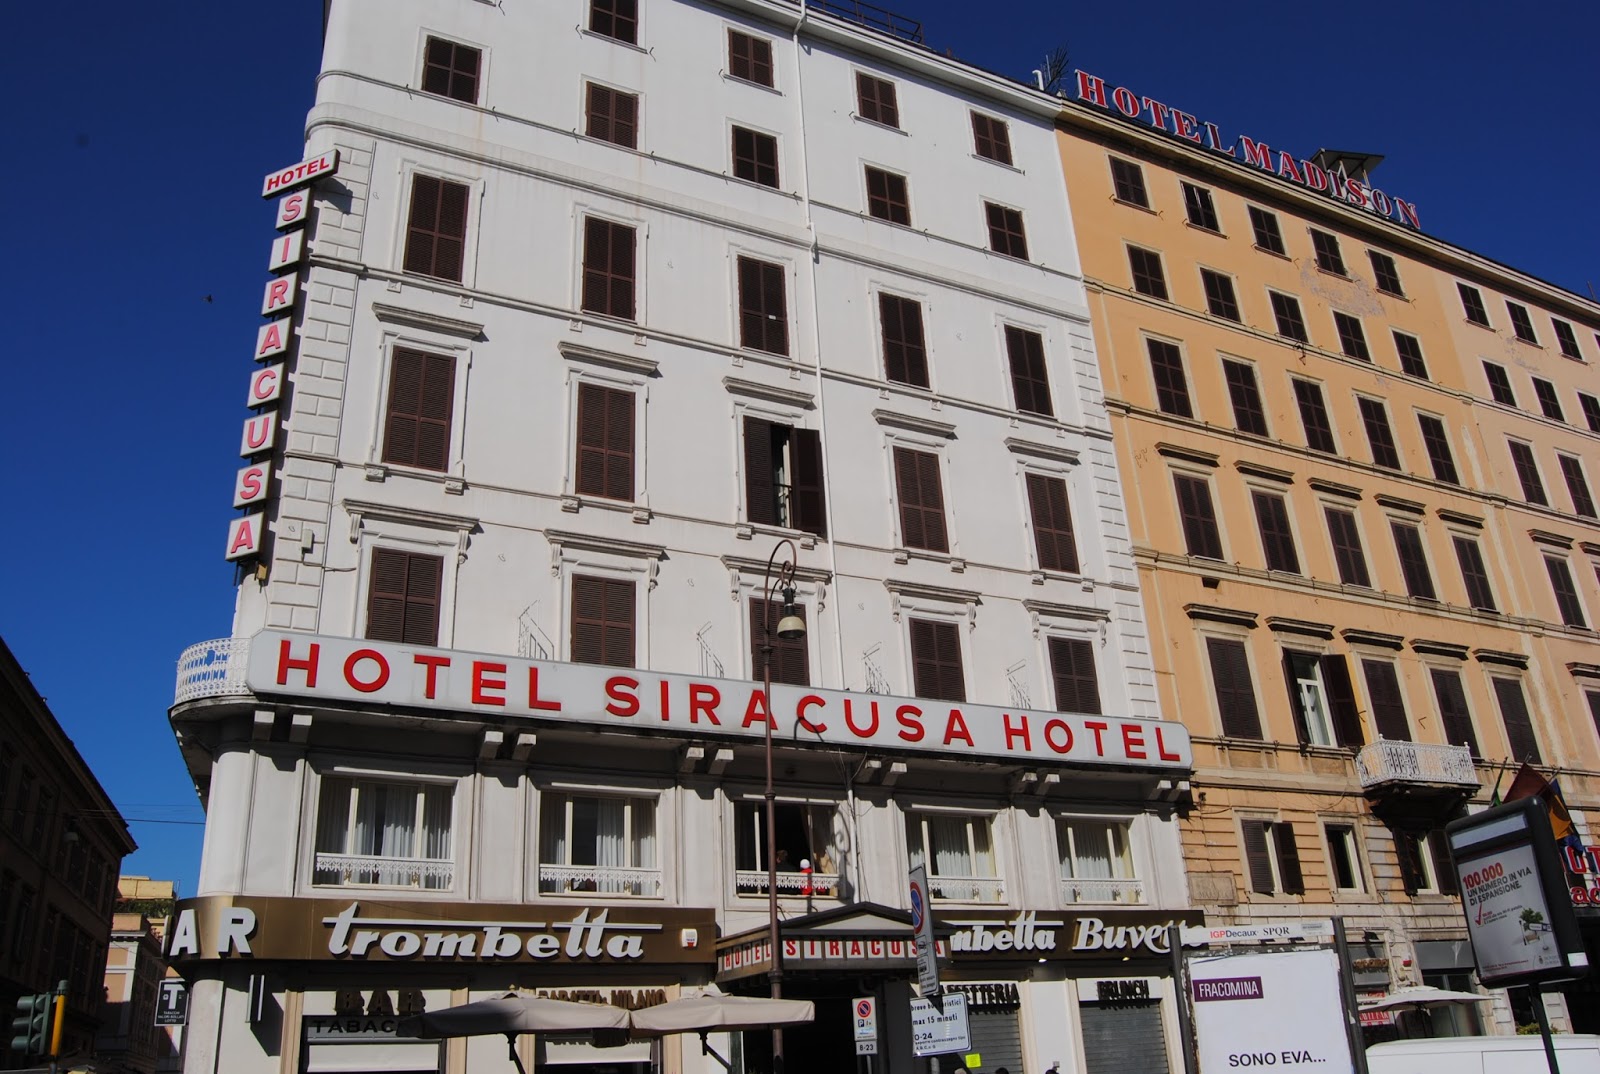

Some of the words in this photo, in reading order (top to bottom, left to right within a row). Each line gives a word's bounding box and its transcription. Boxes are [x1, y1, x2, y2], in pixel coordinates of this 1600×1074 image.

[1075, 69, 1235, 157] HOTEL
[1239, 134, 1421, 229] MADISON
[267, 157, 330, 191] HOTEL
[230, 195, 303, 554] SIRACUSA
[276, 640, 562, 712] HOTEL
[605, 676, 974, 747] SIRACUSA
[1003, 714, 1181, 762] HOTEL
[1462, 862, 1504, 890] 100.000
[1467, 887, 1478, 898] UN
[1479, 877, 1508, 895] NUMERO
[1509, 873, 1516, 883] IN
[1517, 867, 1532, 880] VIA
[1470, 897, 1478, 906] DI
[163, 905, 256, 957] AR
[322, 901, 663, 959] trombetta
[942, 910, 1064, 952] mbetta
[1072, 917, 1206, 954] Buvet
[1210, 930, 1257, 939] IGPDecaux
[1263, 926, 1290, 936] SPQR
[725, 939, 771, 967] HOTEL
[1199, 981, 1259, 998] FRACOMINA
[313, 1019, 397, 1034] TABAC
[927, 1015, 935, 1023] 15
[936, 1013, 958, 1022] minuti
[914, 1032, 933, 1040] 0-24
[1229, 1053, 1276, 1067] SONO
[1282, 1050, 1326, 1064] EVA...
